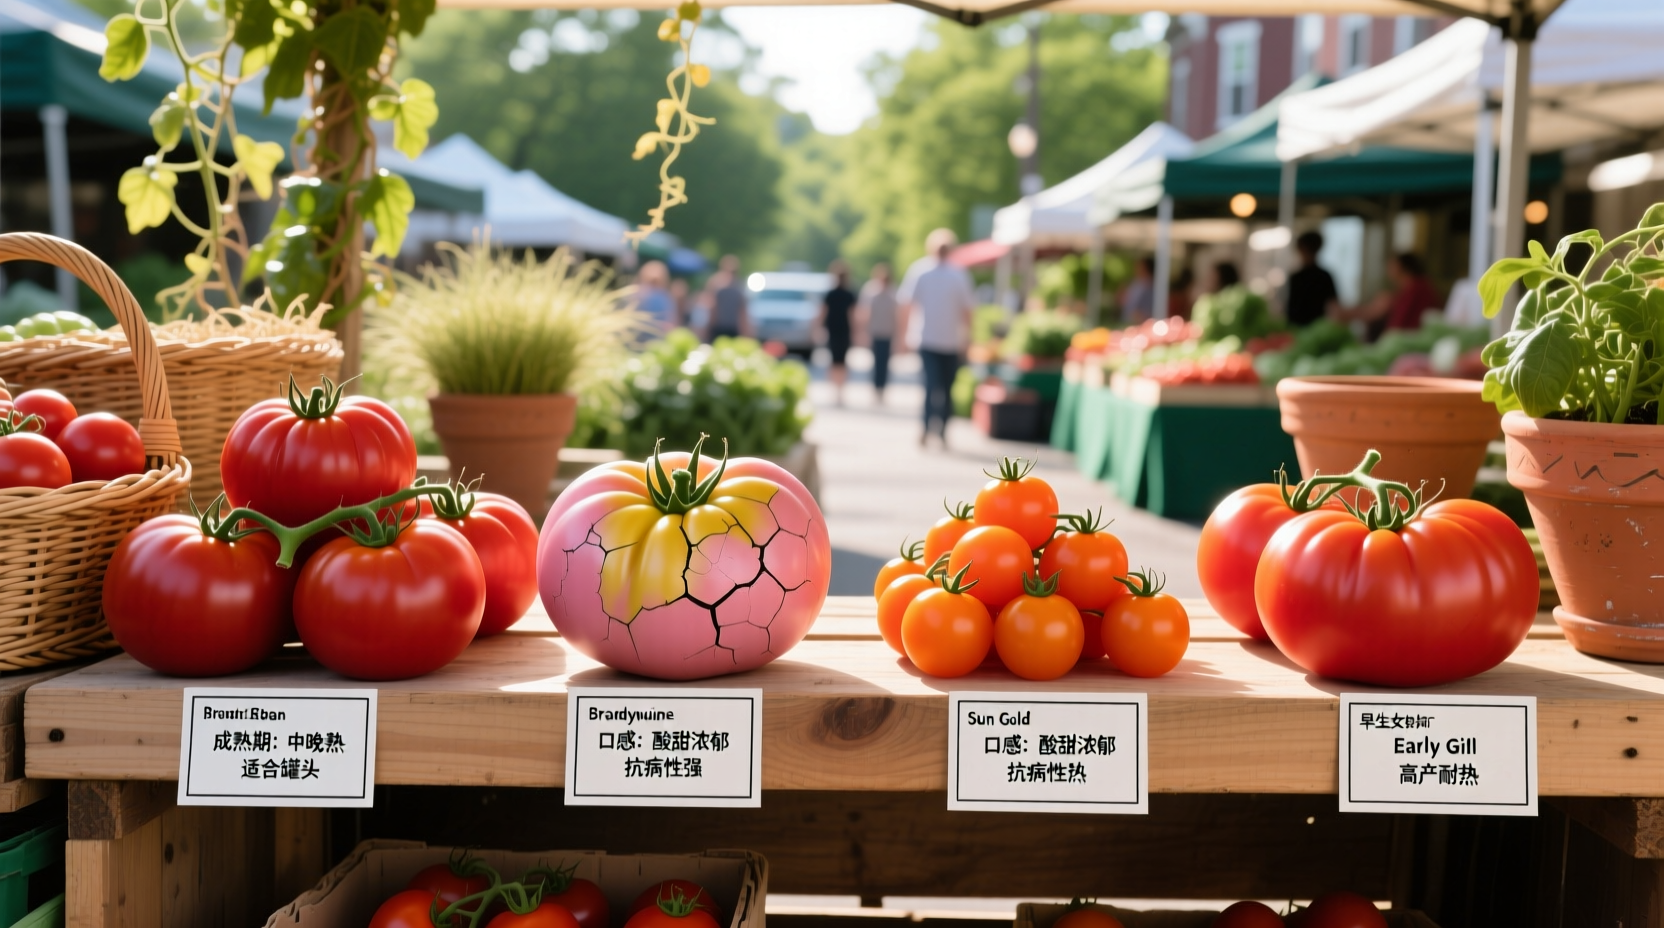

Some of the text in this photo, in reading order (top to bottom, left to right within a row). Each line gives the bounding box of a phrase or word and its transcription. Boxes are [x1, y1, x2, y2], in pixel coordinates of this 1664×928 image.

[967, 710, 1031, 726] Sun Gold
[1394, 735, 1477, 760] Early Gill
[240, 757, 320, 780] 适合罐头
[624, 756, 703, 779] 抗病性强
[1007, 761, 1087, 784] 抗病性热
[1399, 762, 1480, 787] 高产耐热
